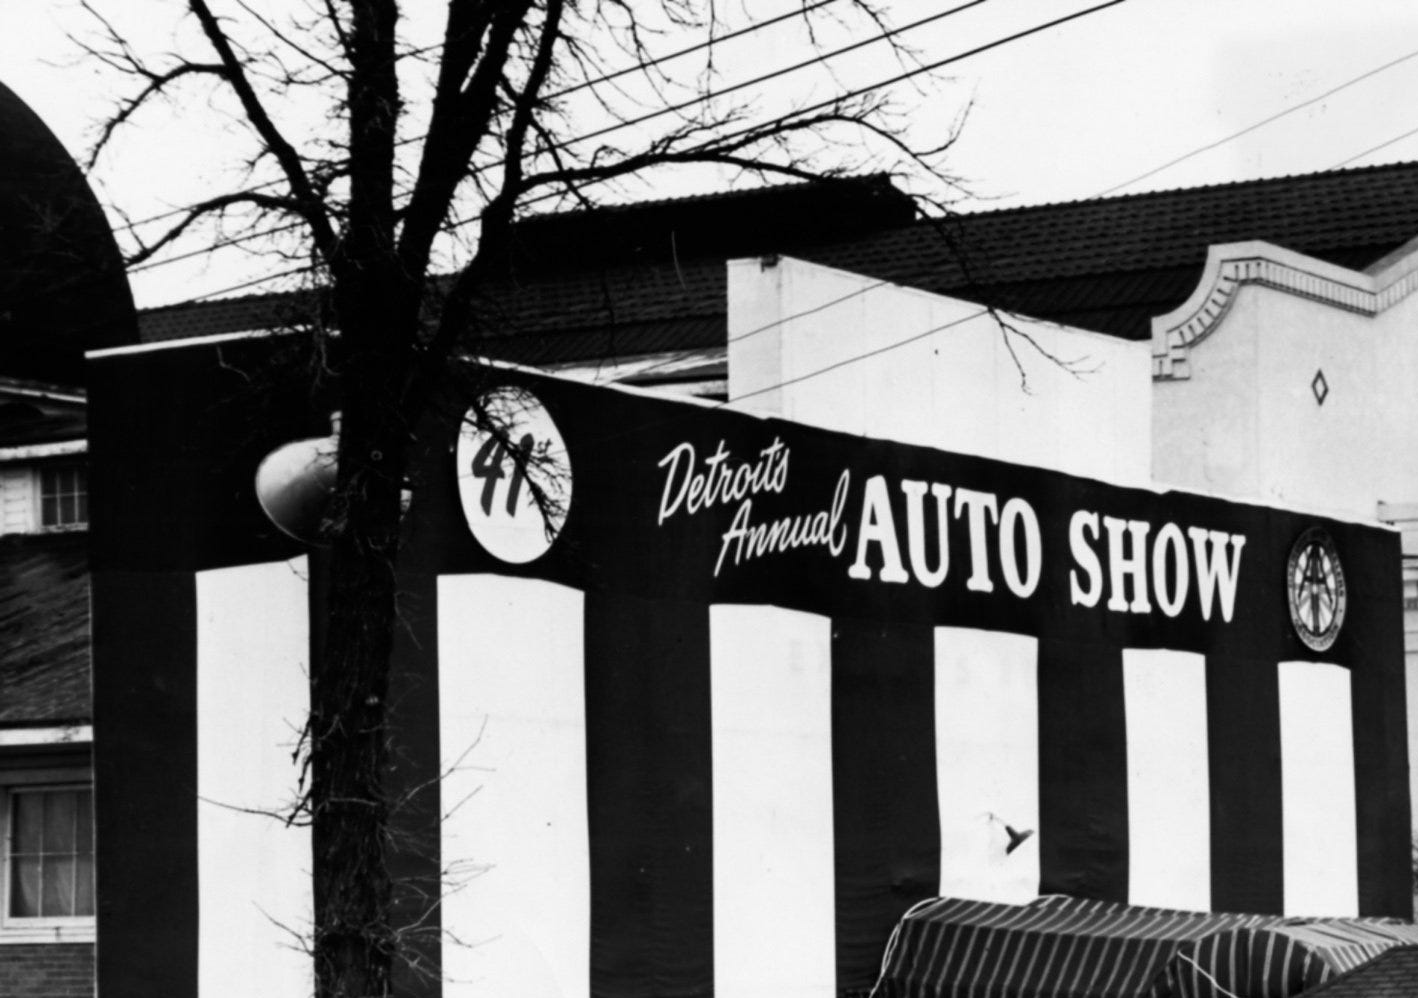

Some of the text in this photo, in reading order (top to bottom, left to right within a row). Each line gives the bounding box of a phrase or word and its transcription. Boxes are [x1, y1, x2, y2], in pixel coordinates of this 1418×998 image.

[657, 436, 790, 527] Detroit's
[713, 468, 850, 578] Annual
[847, 475, 1042, 598] AUTO
[1069, 510, 1246, 623] SHOW
